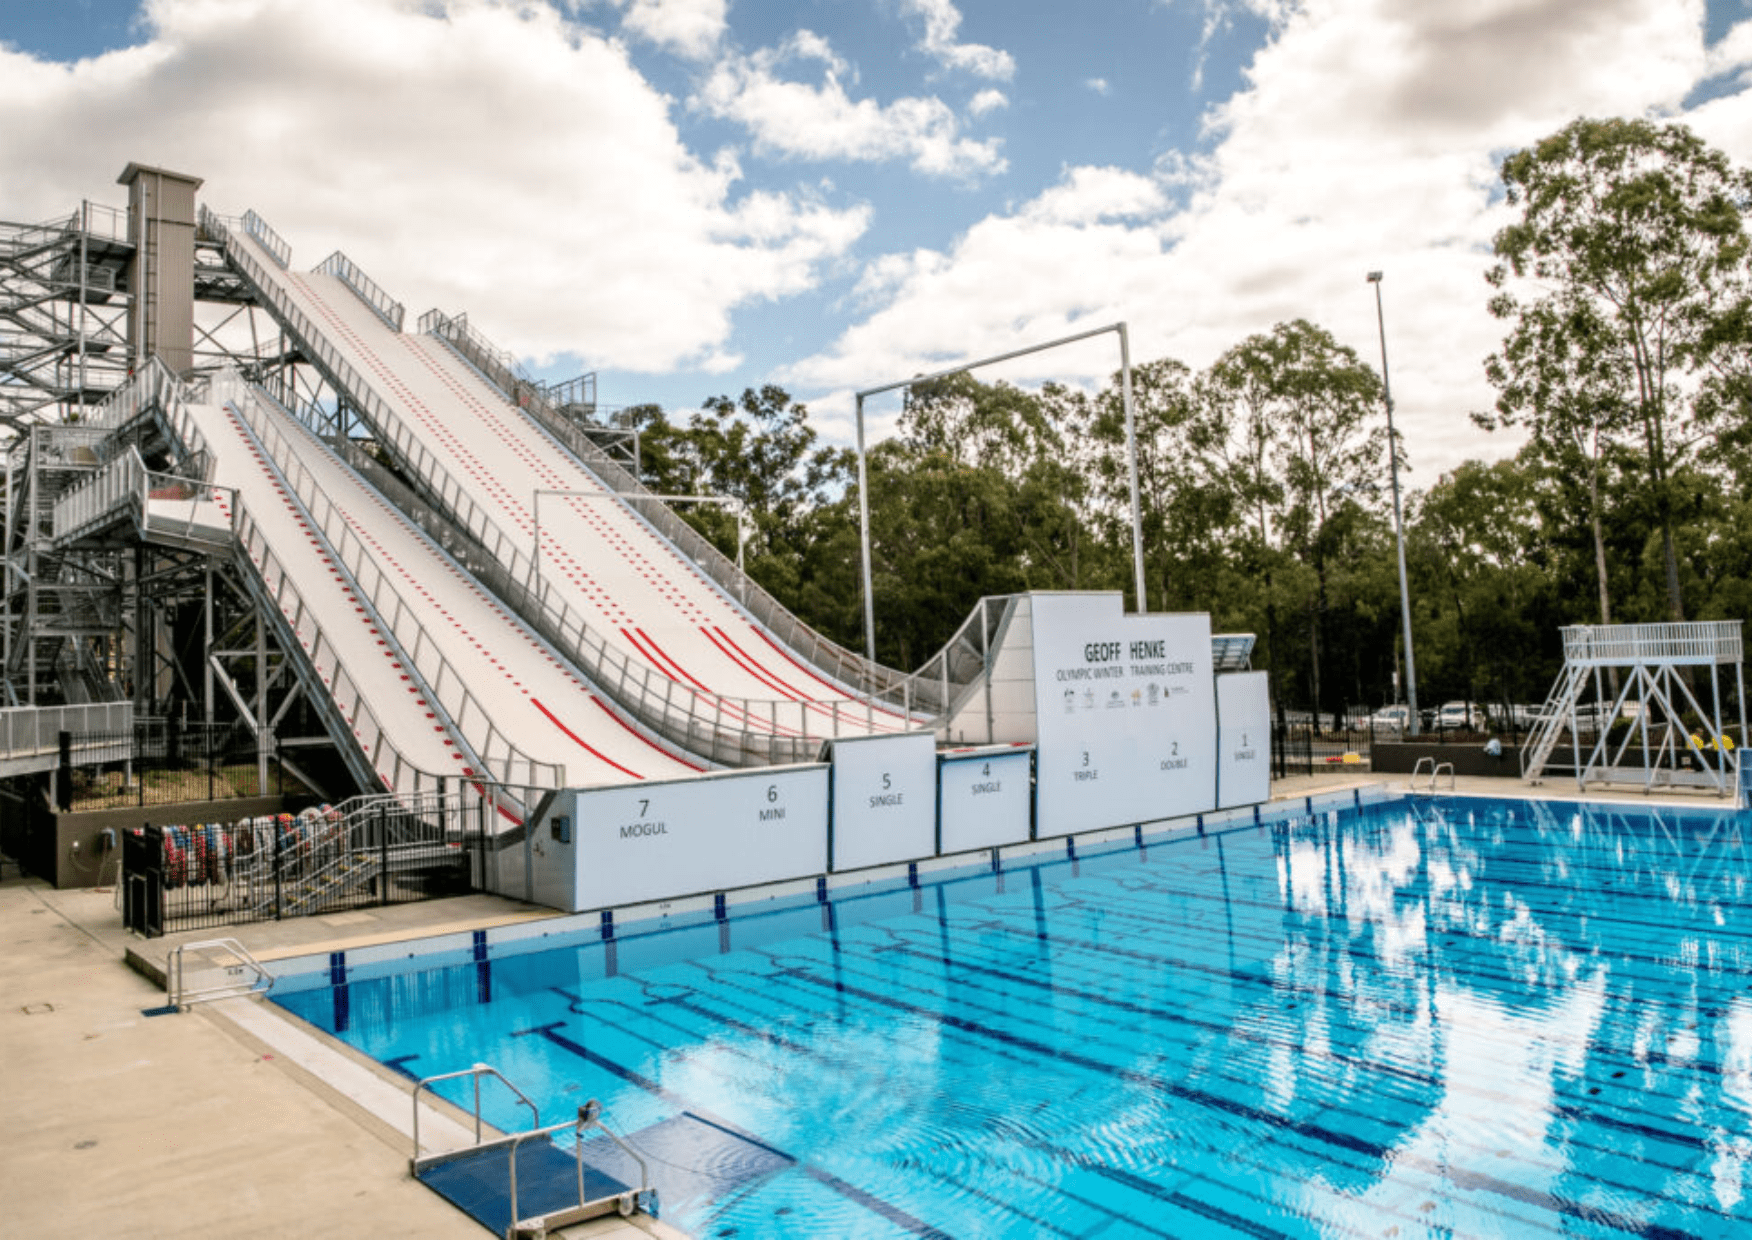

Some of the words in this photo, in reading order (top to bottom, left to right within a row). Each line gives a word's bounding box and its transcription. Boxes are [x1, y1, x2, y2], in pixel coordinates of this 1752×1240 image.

[1084, 642, 1121, 662] GEOFF
[1129, 640, 1165, 660] HENKE
[1056, 668, 1092, 681] OLYMPIC
[1093, 665, 1123, 680] WINTER
[1130, 663, 1165, 677] TRAINING
[1166, 661, 1195, 675] CENTRE
[1242, 733, 1248, 747] 1
[1171, 741, 1178, 756] 2
[1082, 751, 1090, 767] 3
[1160, 758, 1188, 771] DOUBLE
[982, 762, 991, 777] 4
[1074, 769, 1099, 782] TRIPLE
[882, 772, 892, 790] 5
[971, 781, 1001, 795] SINGLE
[767, 785, 778, 803] 6
[869, 793, 903, 808] SINGLE
[639, 799, 650, 818] 7
[759, 808, 786, 821] MINI
[619, 822, 668, 839] MOGUL
